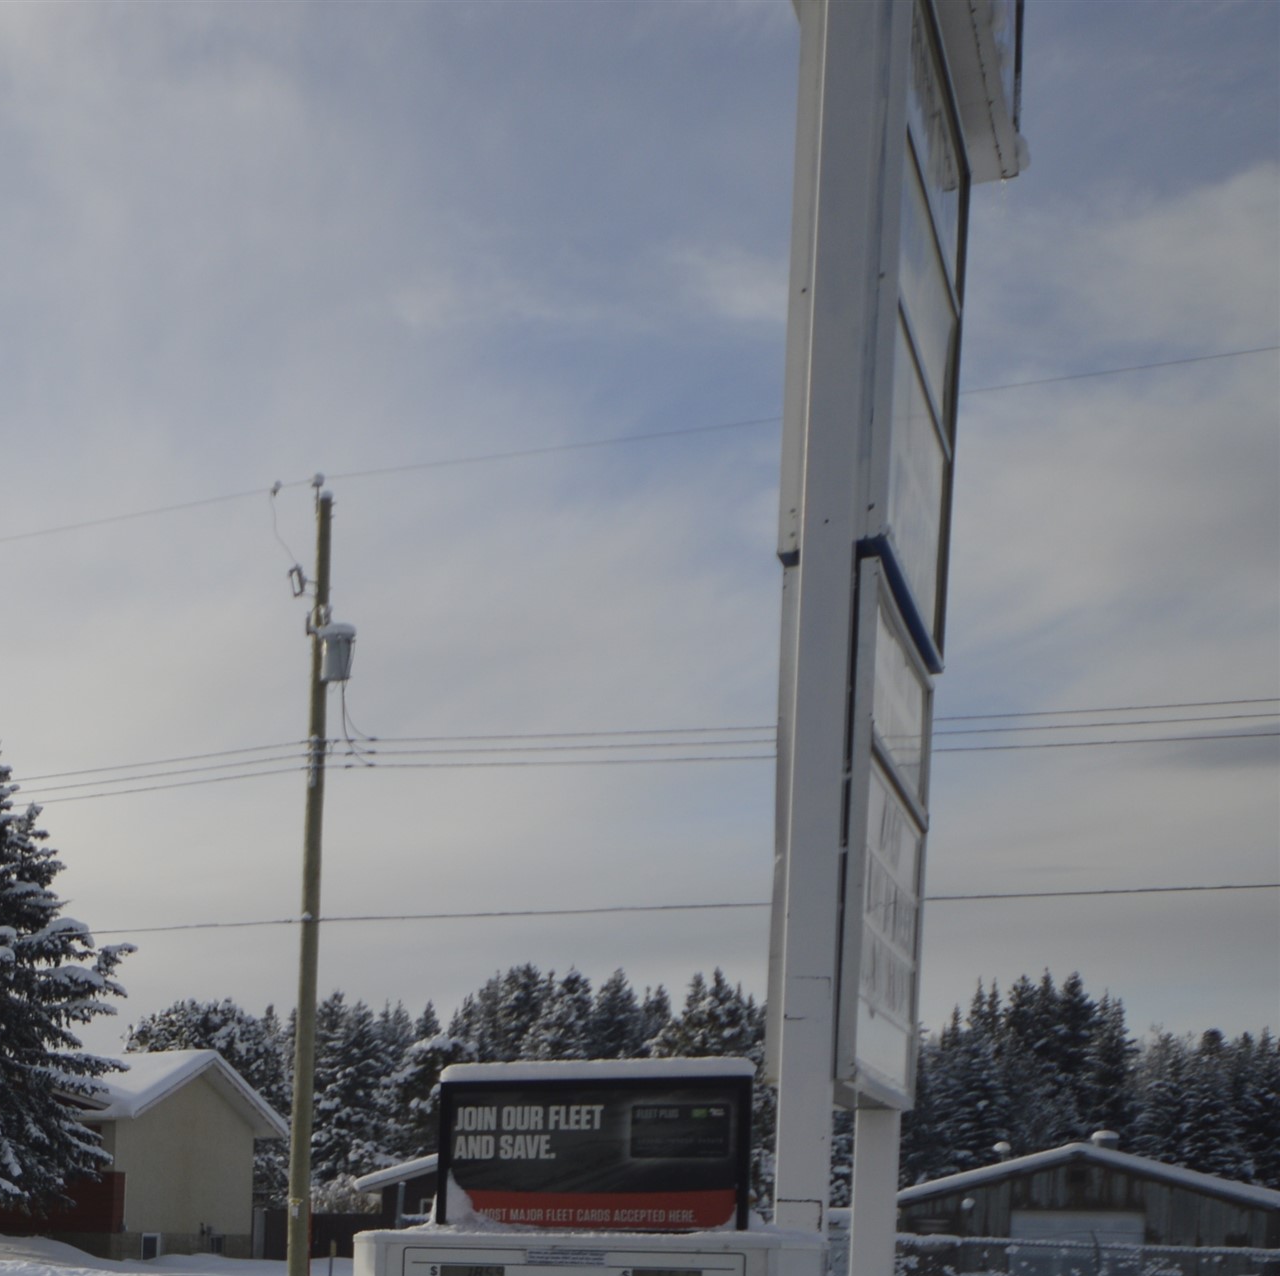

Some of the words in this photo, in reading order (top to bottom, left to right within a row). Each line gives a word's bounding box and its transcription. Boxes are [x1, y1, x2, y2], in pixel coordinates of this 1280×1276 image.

[454, 1106, 497, 1131] JOIN
[502, 1105, 545, 1131] OUR
[548, 1105, 604, 1130] FLEET
[453, 1135, 497, 1160] AND
[500, 1135, 557, 1160] SAVE.
[479, 1207, 507, 1221] MOST
[509, 1208, 544, 1221] MAJOR
[546, 1208, 574, 1222] FLEET
[577, 1209, 611, 1222] CARDS
[613, 1209, 666, 1223] ACCEPTED
[668, 1210, 697, 1223] HERE.
[430, 1265, 438, 1276] $
